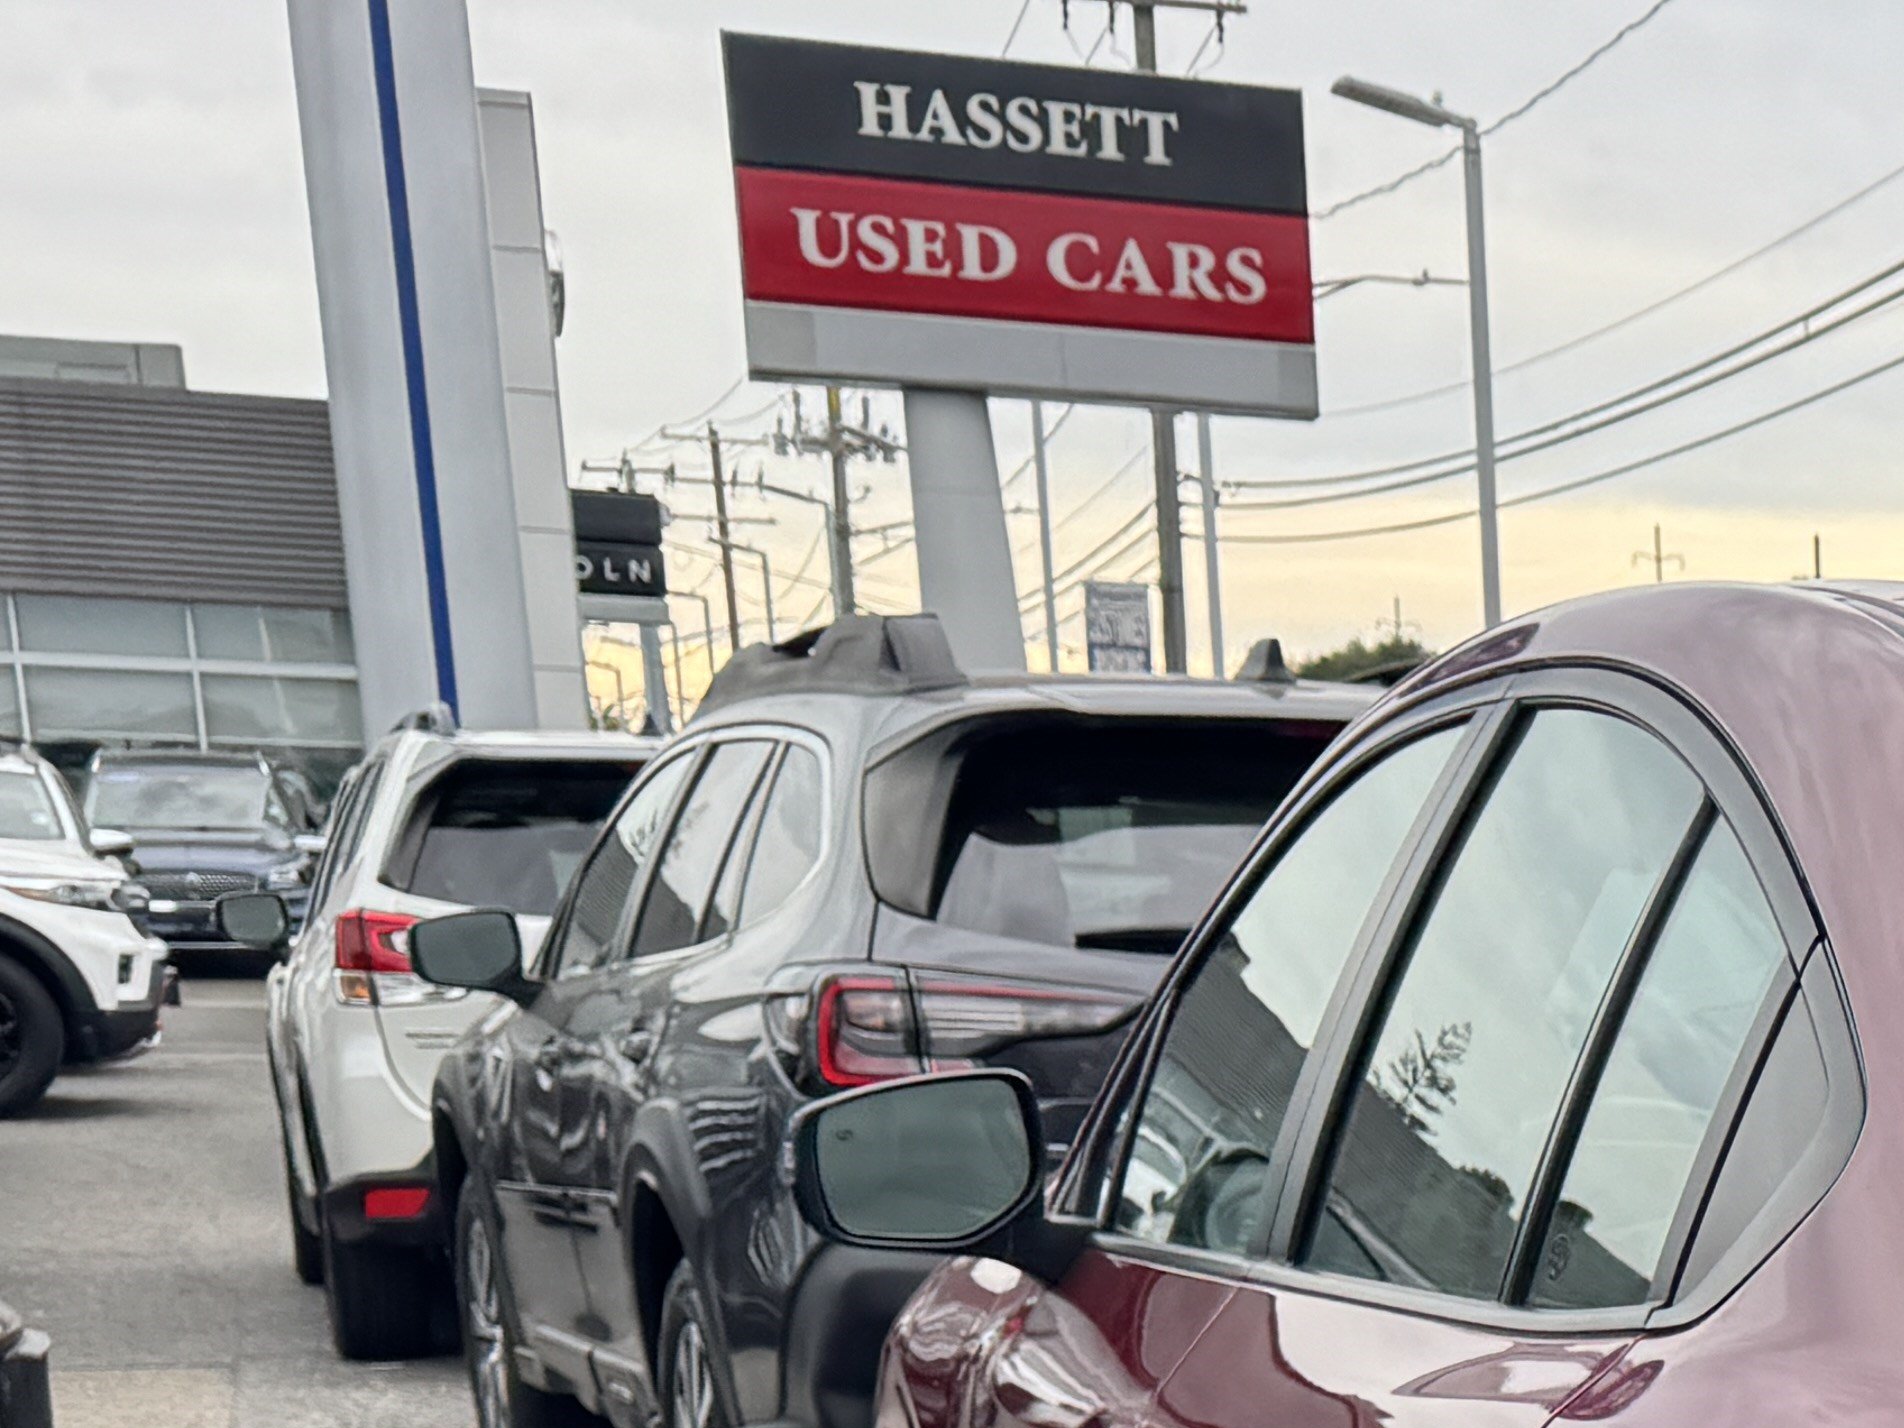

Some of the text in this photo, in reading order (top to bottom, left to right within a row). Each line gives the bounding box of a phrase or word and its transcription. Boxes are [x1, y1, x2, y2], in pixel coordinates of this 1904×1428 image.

[853, 81, 1180, 166] HASSETT
[790, 207, 1267, 304] USED CARS
